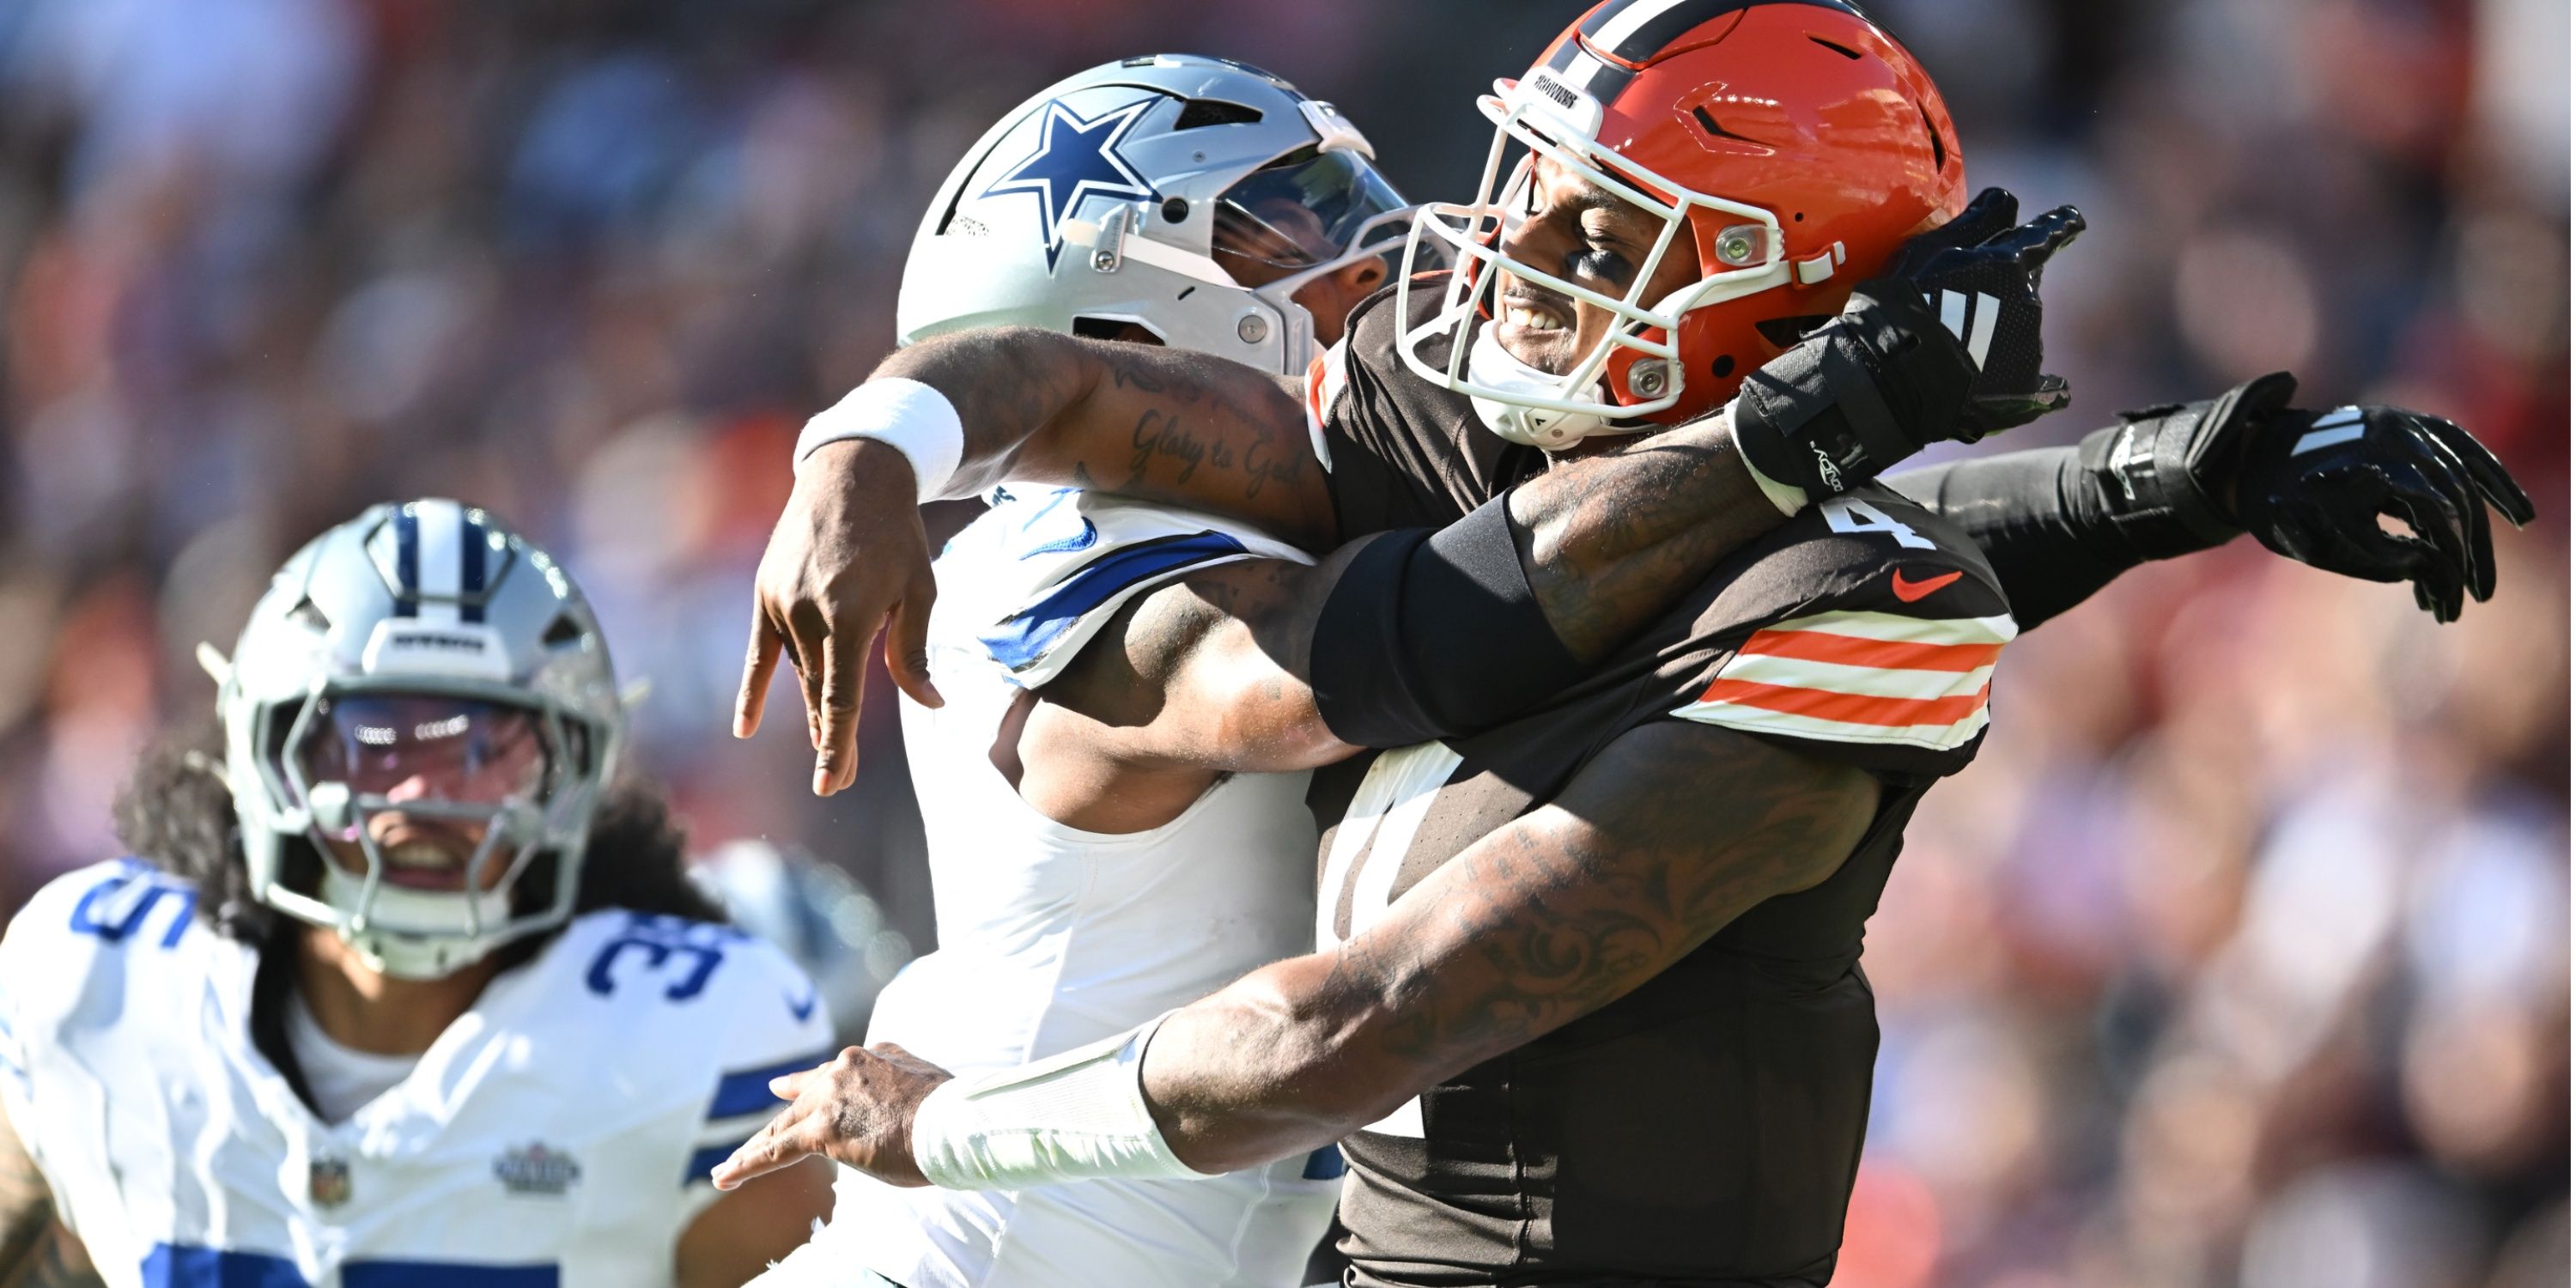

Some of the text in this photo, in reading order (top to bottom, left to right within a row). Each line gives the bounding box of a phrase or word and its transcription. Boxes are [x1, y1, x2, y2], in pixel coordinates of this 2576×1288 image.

[1534, 75, 1578, 109] BROWNS
[1129, 409, 1204, 484] Glory
[1819, 496, 1937, 551] 4
